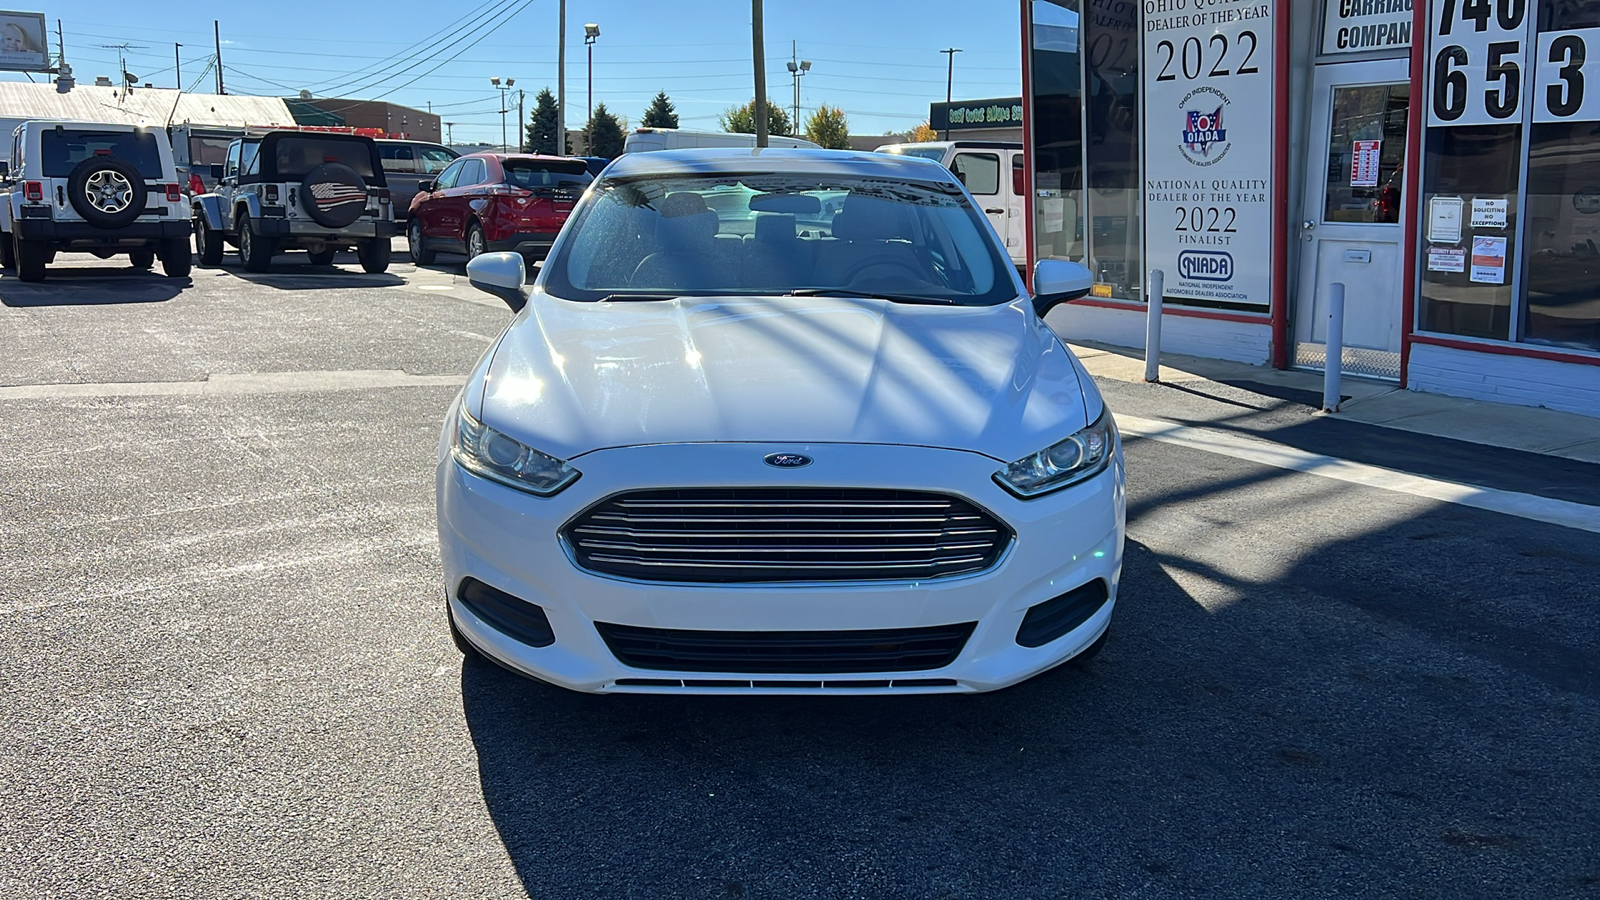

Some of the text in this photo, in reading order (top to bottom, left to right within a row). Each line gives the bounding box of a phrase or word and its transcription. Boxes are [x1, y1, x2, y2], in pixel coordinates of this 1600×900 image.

[1147, 15, 1190, 32] DEALER
[1192, 13, 1208, 27] OF
[1210, 9, 1234, 24] THE
[1236, 4, 1269, 20] YEAR
[1337, 21, 1412, 49] COMPAN
[1156, 30, 1259, 82] 2022
[1178, 86, 1232, 109] OHIO INDEPENDENT
[1187, 130, 1219, 143] OIADA
[1148, 180, 1267, 191] NATIONAL QUALITY
[1149, 193, 1265, 203] DEALER OF THE YEAR
[1175, 206, 1237, 233] 2022
[1178, 234, 1231, 245] FINALIST
[1182, 256, 1228, 275] NIADA
[1178, 281, 1201, 289] NATIONAL
[1214, 292, 1248, 300] ASSOCIATION
